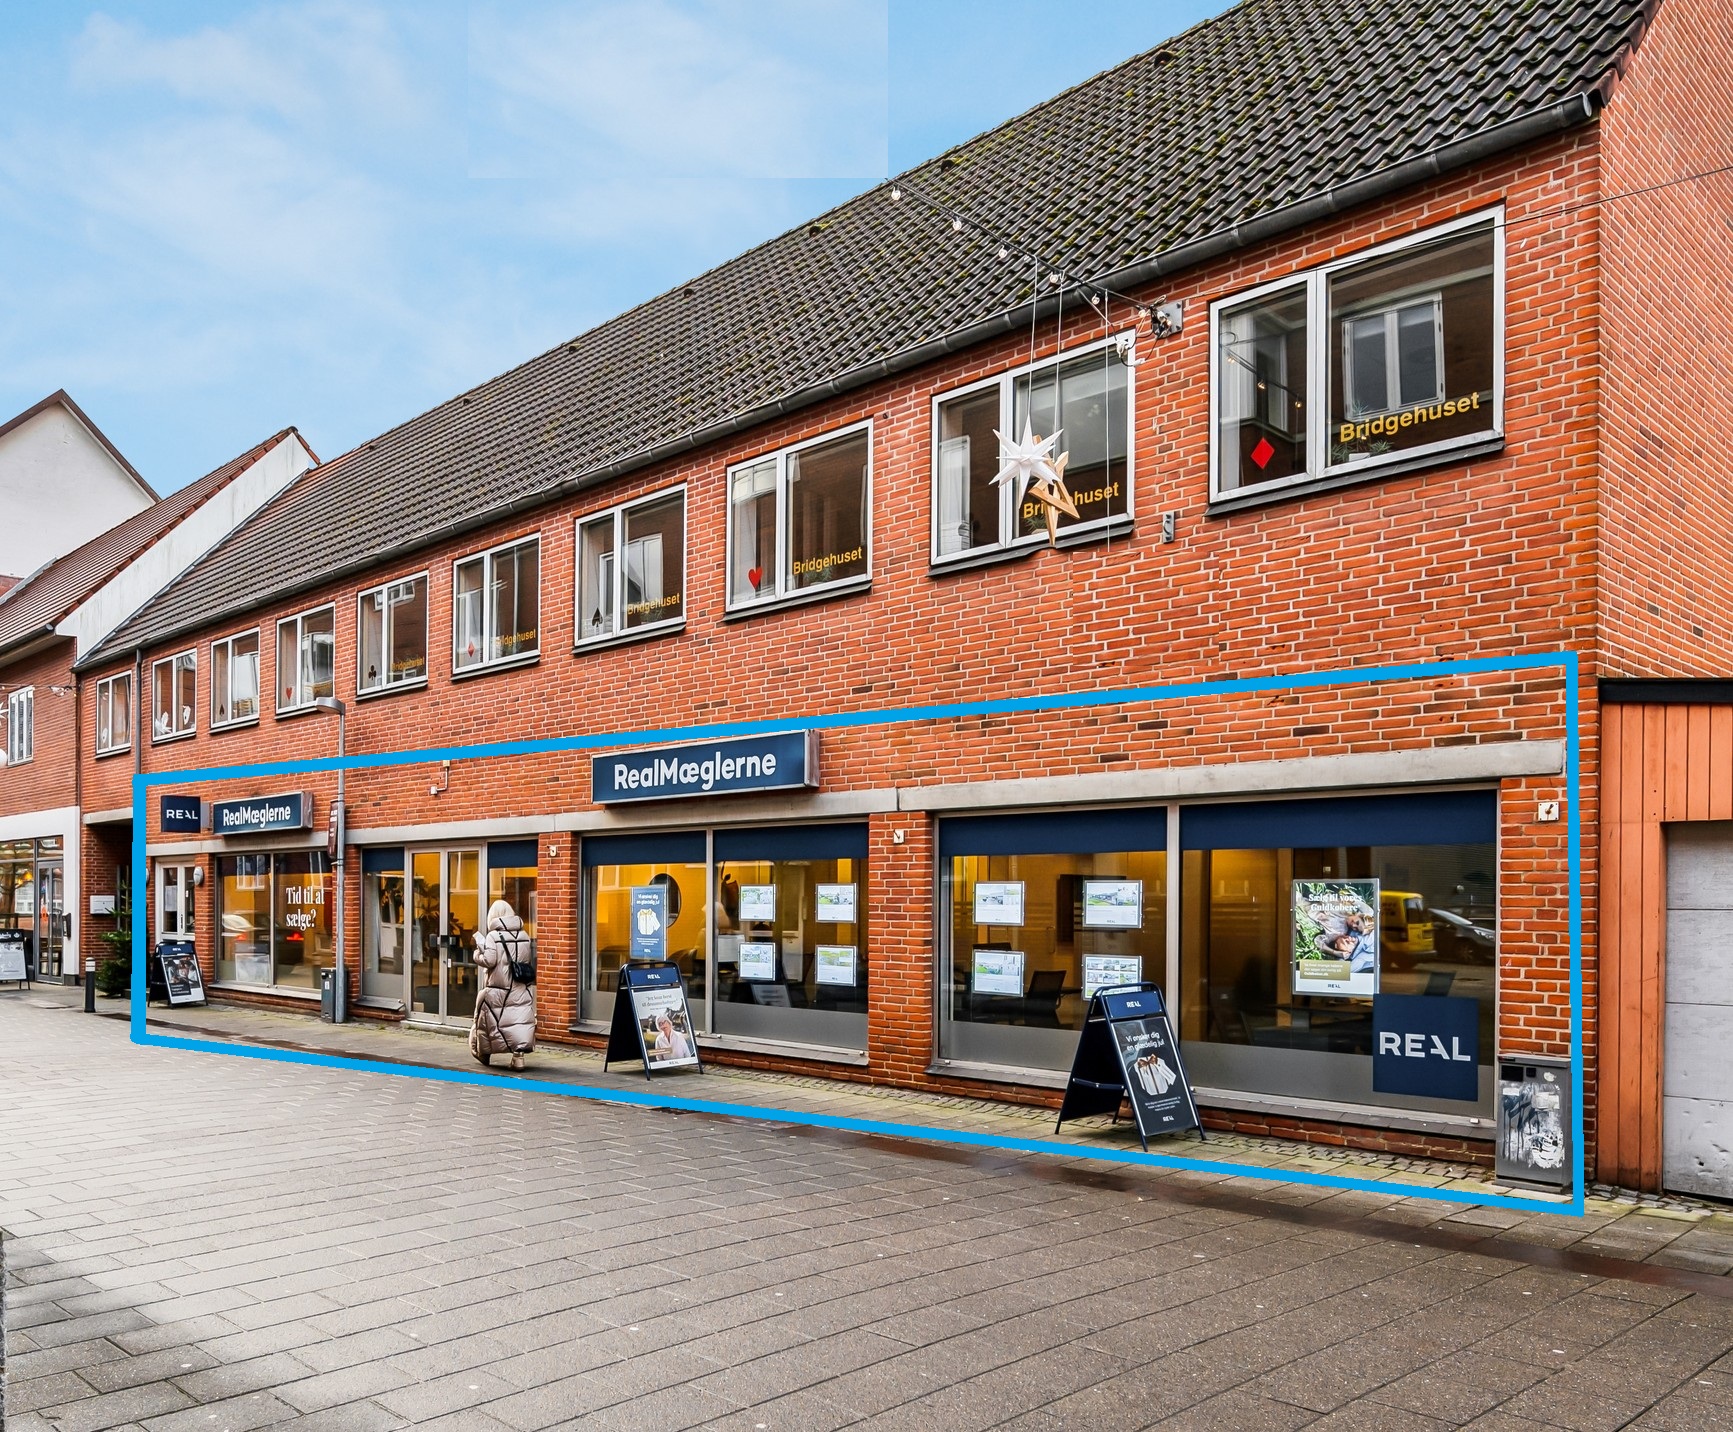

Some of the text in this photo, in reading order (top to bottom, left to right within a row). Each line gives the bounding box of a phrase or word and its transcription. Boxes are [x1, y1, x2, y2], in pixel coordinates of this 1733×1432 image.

[1340, 391, 1480, 443] Bridgehuset
[1023, 482, 1119, 518] Brihuset
[793, 546, 862, 575] Bridgehuset
[628, 592, 680, 615] Bridgehuset
[614, 751, 777, 791] RealMæglerne
[166, 809, 199, 820] REAL
[222, 803, 291, 828] RealMæglerne
[286, 886, 325, 904] Tid til at
[286, 909, 317, 931] sælge?
[1151, 1031, 1160, 1039] dig
[1379, 1031, 1471, 1062] REAL
